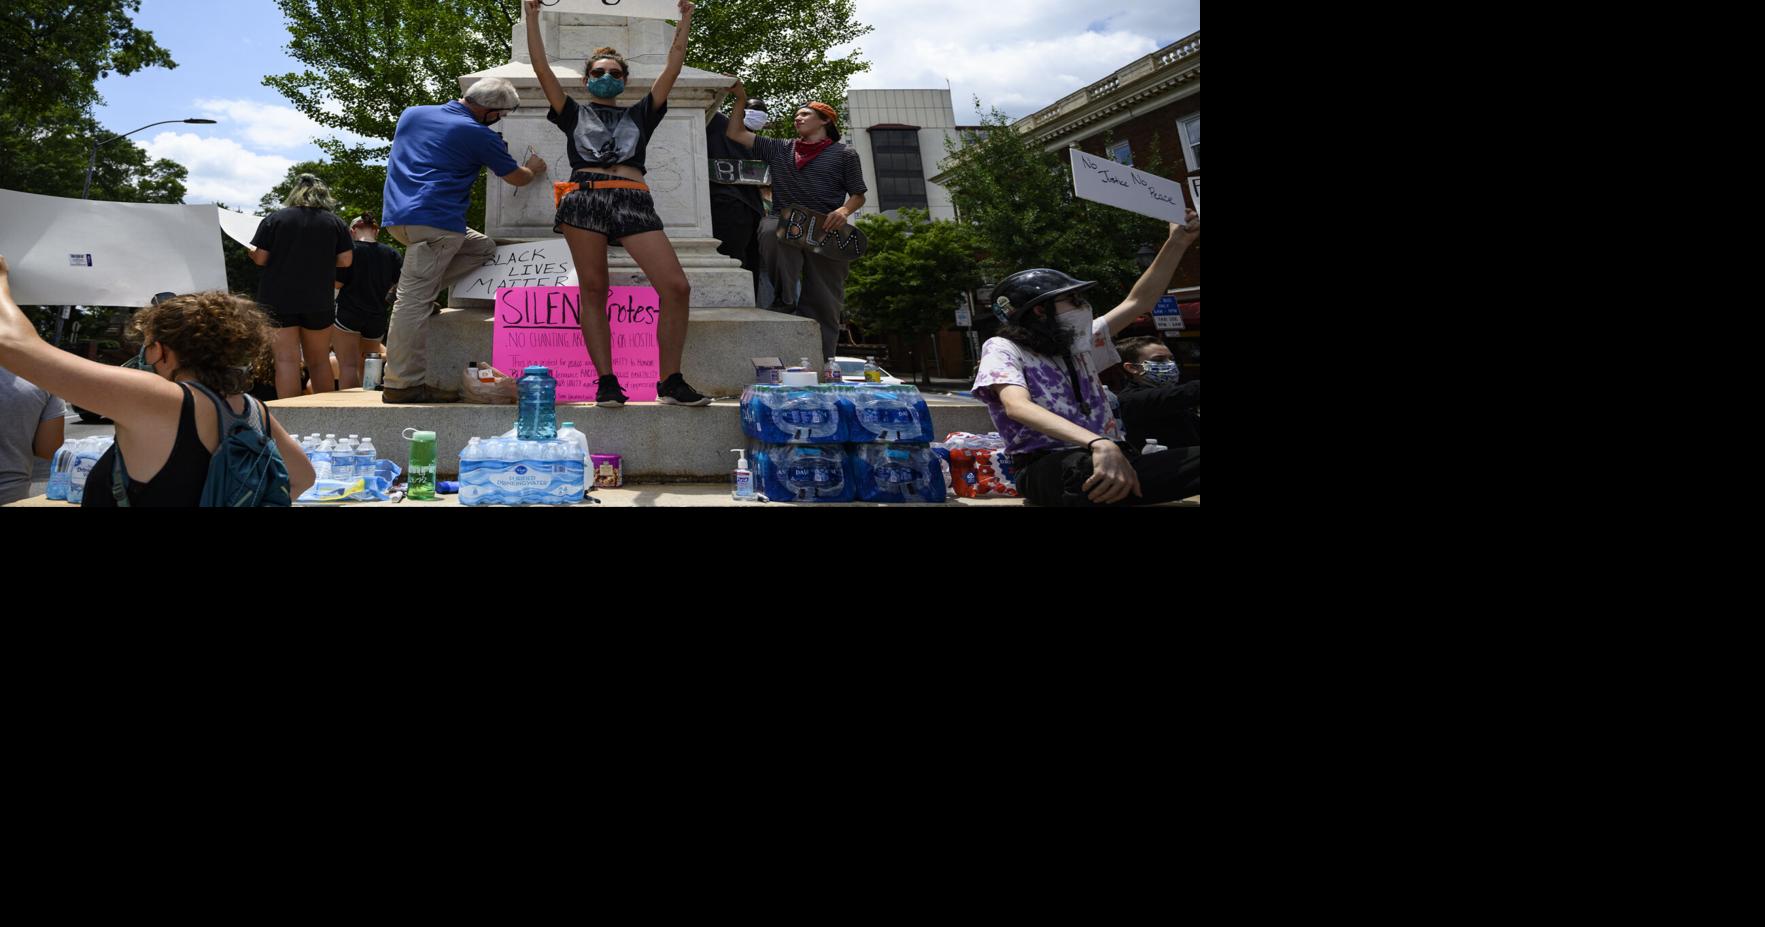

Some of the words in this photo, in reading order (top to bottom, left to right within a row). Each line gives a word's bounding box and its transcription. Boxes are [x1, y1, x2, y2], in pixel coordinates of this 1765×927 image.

[1081, 155, 1097, 170] No
[1098, 170, 1129, 188] Justice
[1130, 171, 1148, 187] No
[1148, 186, 1177, 206] Peace
[785, 208, 861, 257] BLM
[508, 262, 568, 277] LIVES
[502, 290, 582, 326] SILEN
[508, 332, 526, 348] NO
[529, 332, 569, 348] CHANTING
[572, 332, 586, 348] AN
[629, 332, 656, 348] HOSTIL
